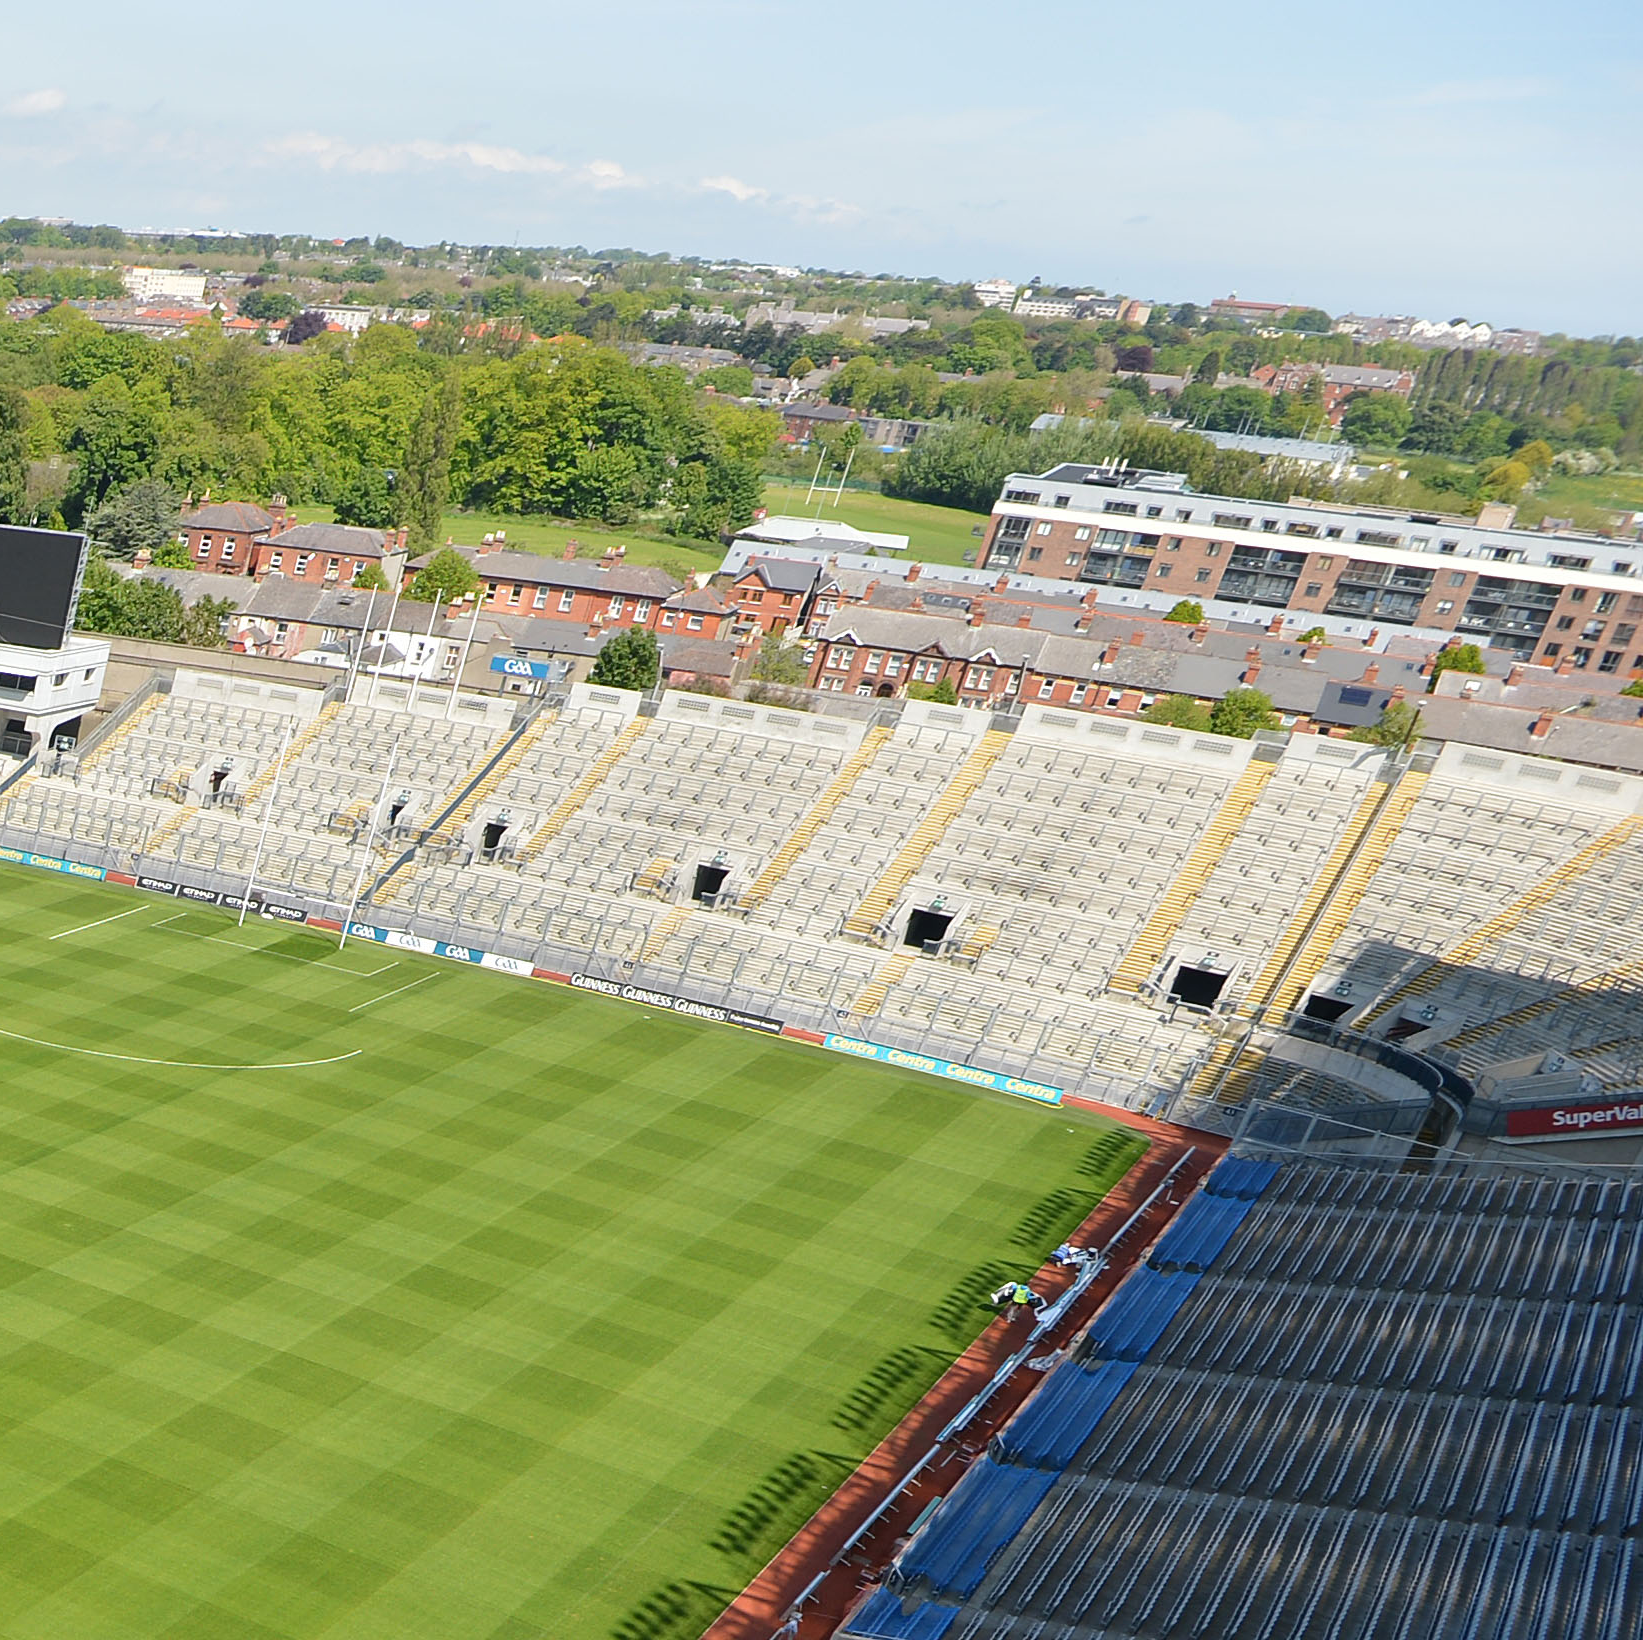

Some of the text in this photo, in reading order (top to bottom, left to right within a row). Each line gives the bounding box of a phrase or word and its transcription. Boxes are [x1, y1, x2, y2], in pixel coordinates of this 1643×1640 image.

[504, 659, 533, 675] GAA
[31, 855, 62, 870] Centra
[70, 863, 102, 877] Centra
[142, 878, 172, 890] ETIHAD
[183, 887, 215, 899] ETIHAD
[269, 905, 302, 918] ETIHAD
[352, 924, 376, 939] GAA
[399, 935, 421, 948] GAA
[445, 945, 470, 960] GAA
[495, 957, 518, 970] GAA
[571, 973, 621, 995] GUINNESS
[622, 985, 673, 1008] GUINNESS
[674, 999, 726, 1021] GUINNESS
[830, 1035, 878, 1056] Centra
[887, 1049, 936, 1070] Centra
[946, 1063, 995, 1084] Centra
[1005, 1078, 1056, 1100] Centra
